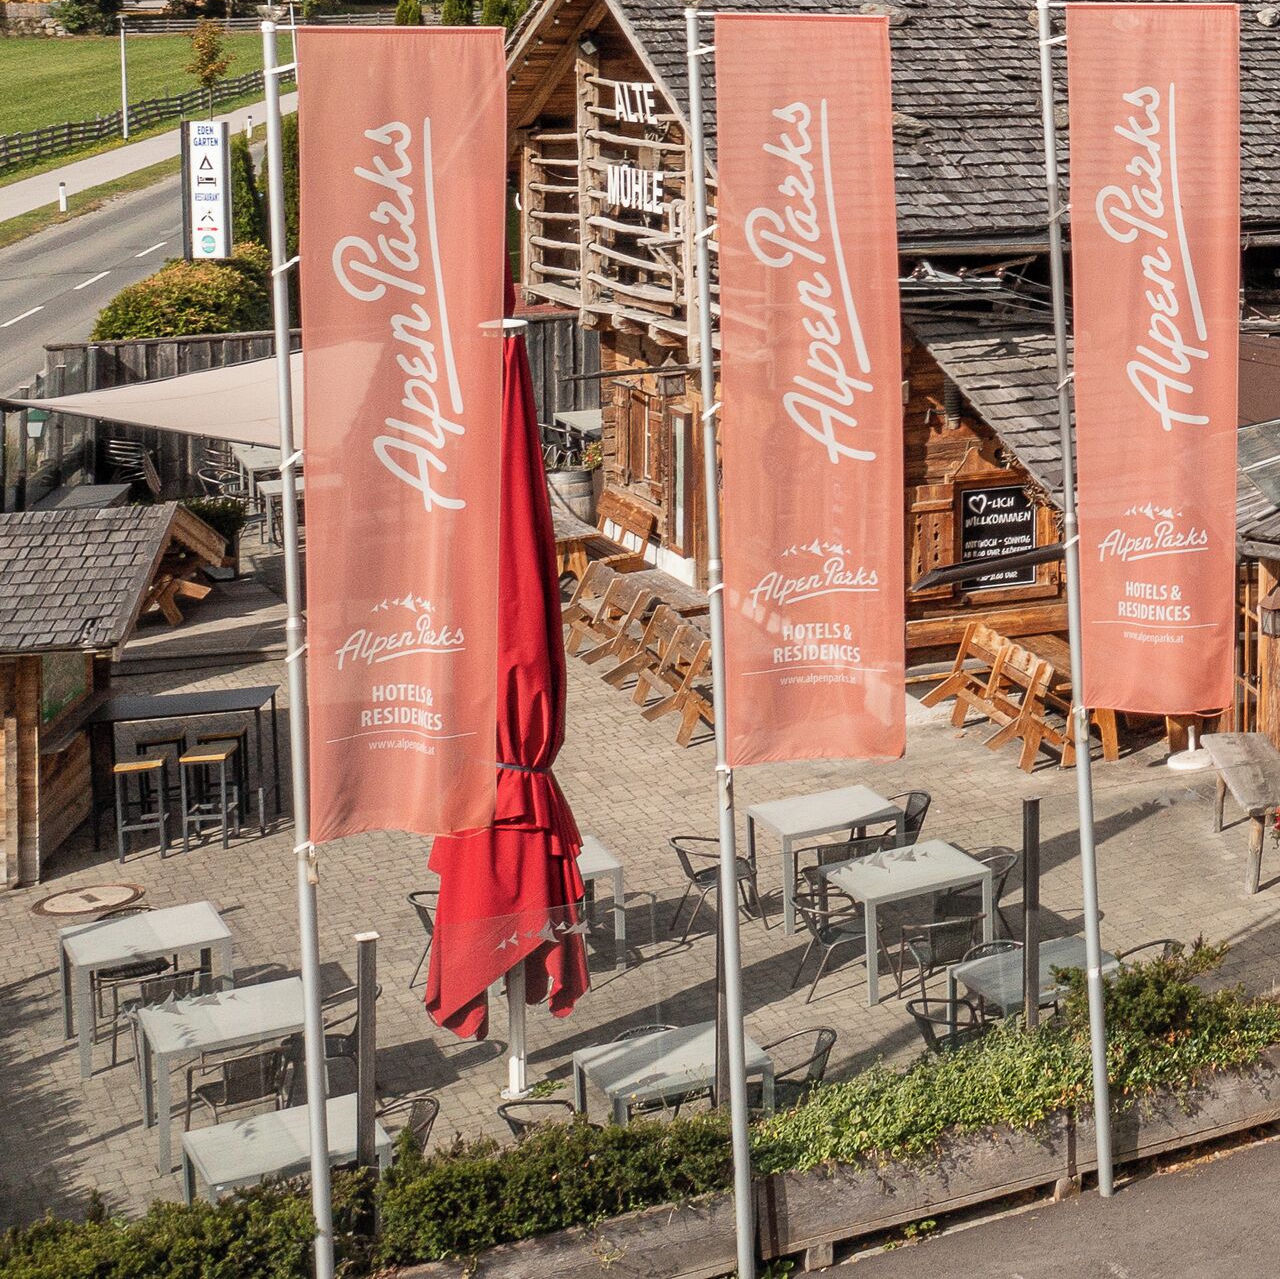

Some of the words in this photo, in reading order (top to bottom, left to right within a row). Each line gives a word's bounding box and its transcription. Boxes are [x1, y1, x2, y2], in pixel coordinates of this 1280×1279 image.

[615, 82, 658, 125] ALTE
[197, 125, 214, 135] EDEN
[193, 137, 219, 146] GARTEN
[965, 510, 1032, 528] WILLKOMMEN
[965, 538, 998, 549] MITTWOCH
[1003, 535, 1031, 546] SONNTAG
[986, 548, 1001, 556] UHR
[1126, 581, 1168, 601] HOTELS
[1171, 585, 1182, 601] &
[1118, 601, 1191, 621] RESIDENCES
[783, 623, 842, 641] HOTELS
[843, 624, 853, 641] &
[773, 644, 861, 664] RESIDENCES
[372, 684, 427, 704] HOTELS
[361, 707, 443, 731] RESIDENCES
